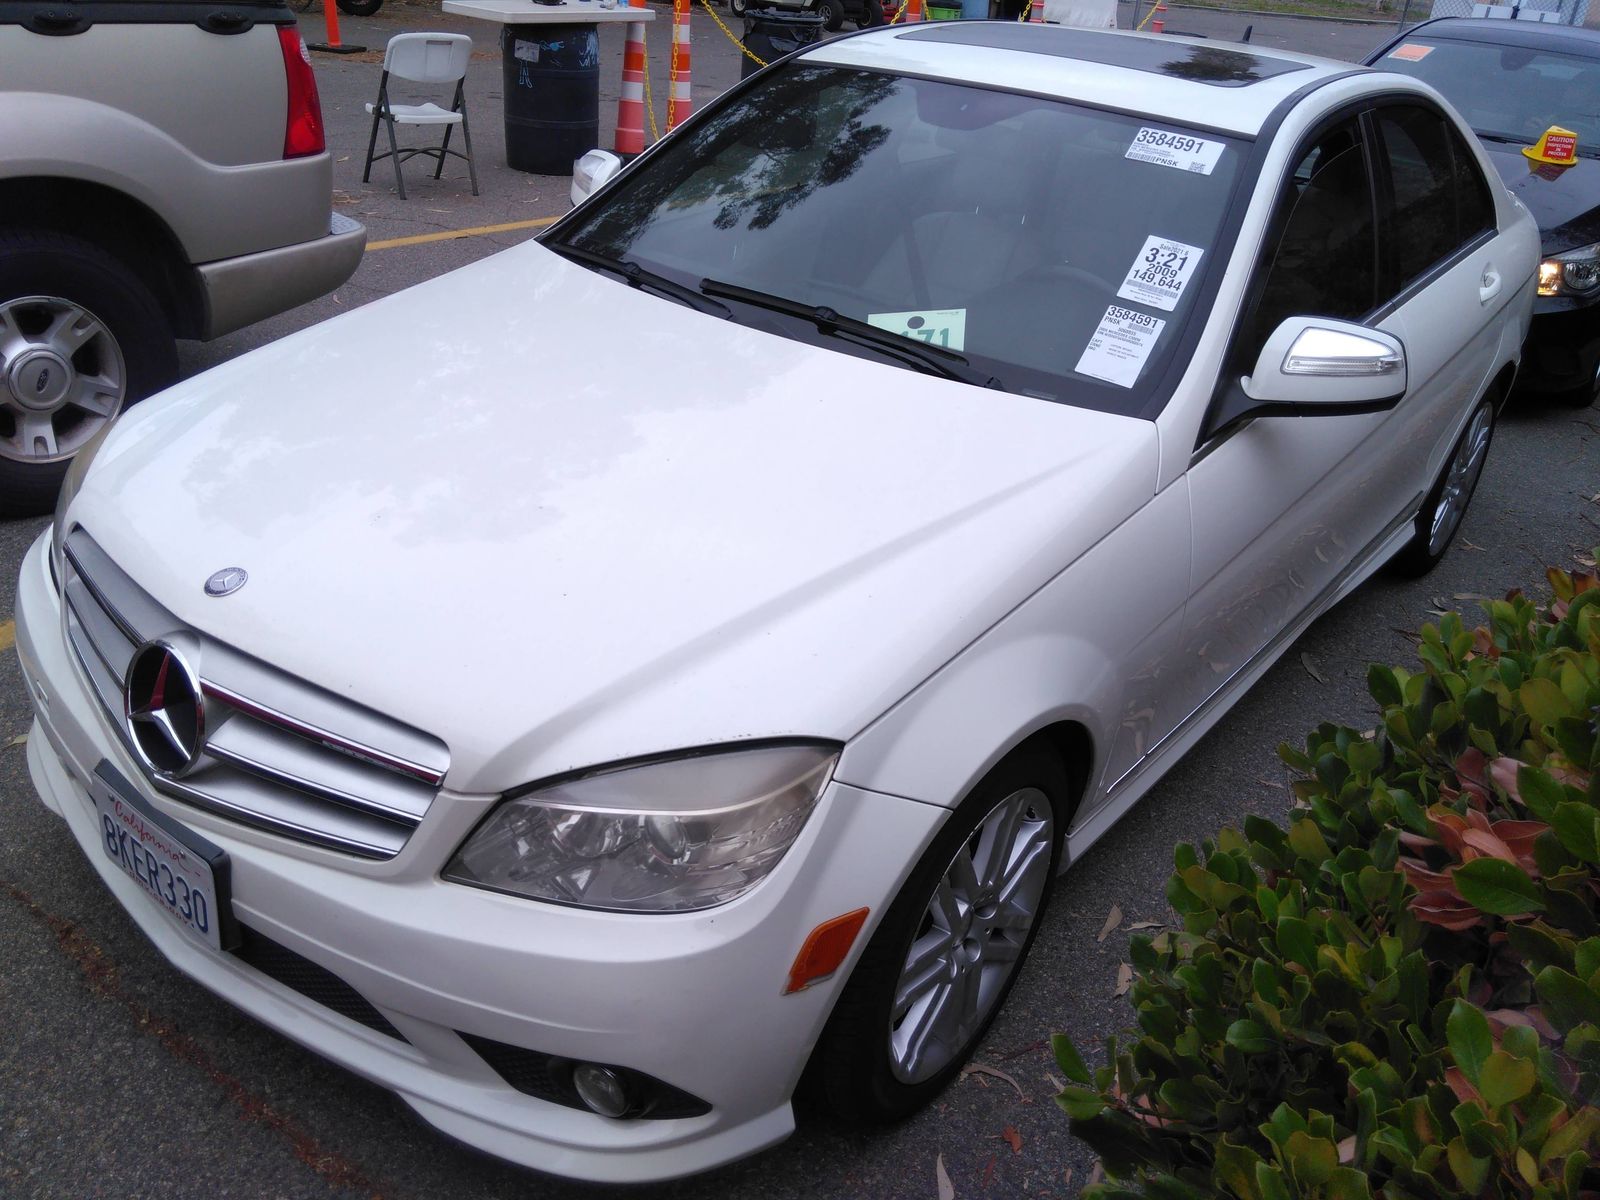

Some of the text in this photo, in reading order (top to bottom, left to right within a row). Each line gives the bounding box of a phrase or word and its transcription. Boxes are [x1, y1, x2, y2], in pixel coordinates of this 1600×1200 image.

[1137, 130, 1204, 154] 3584591
[1547, 135, 1575, 144] CAUTION
[1154, 157, 1179, 167] PNSK
[1145, 247, 1188, 271] 3:21
[1146, 263, 1178, 279] 2009
[1104, 316, 1121, 325] PNSK
[1107, 306, 1158, 329] 3584591
[115, 800, 188, 870] California
[104, 814, 208, 934] 8KER330
